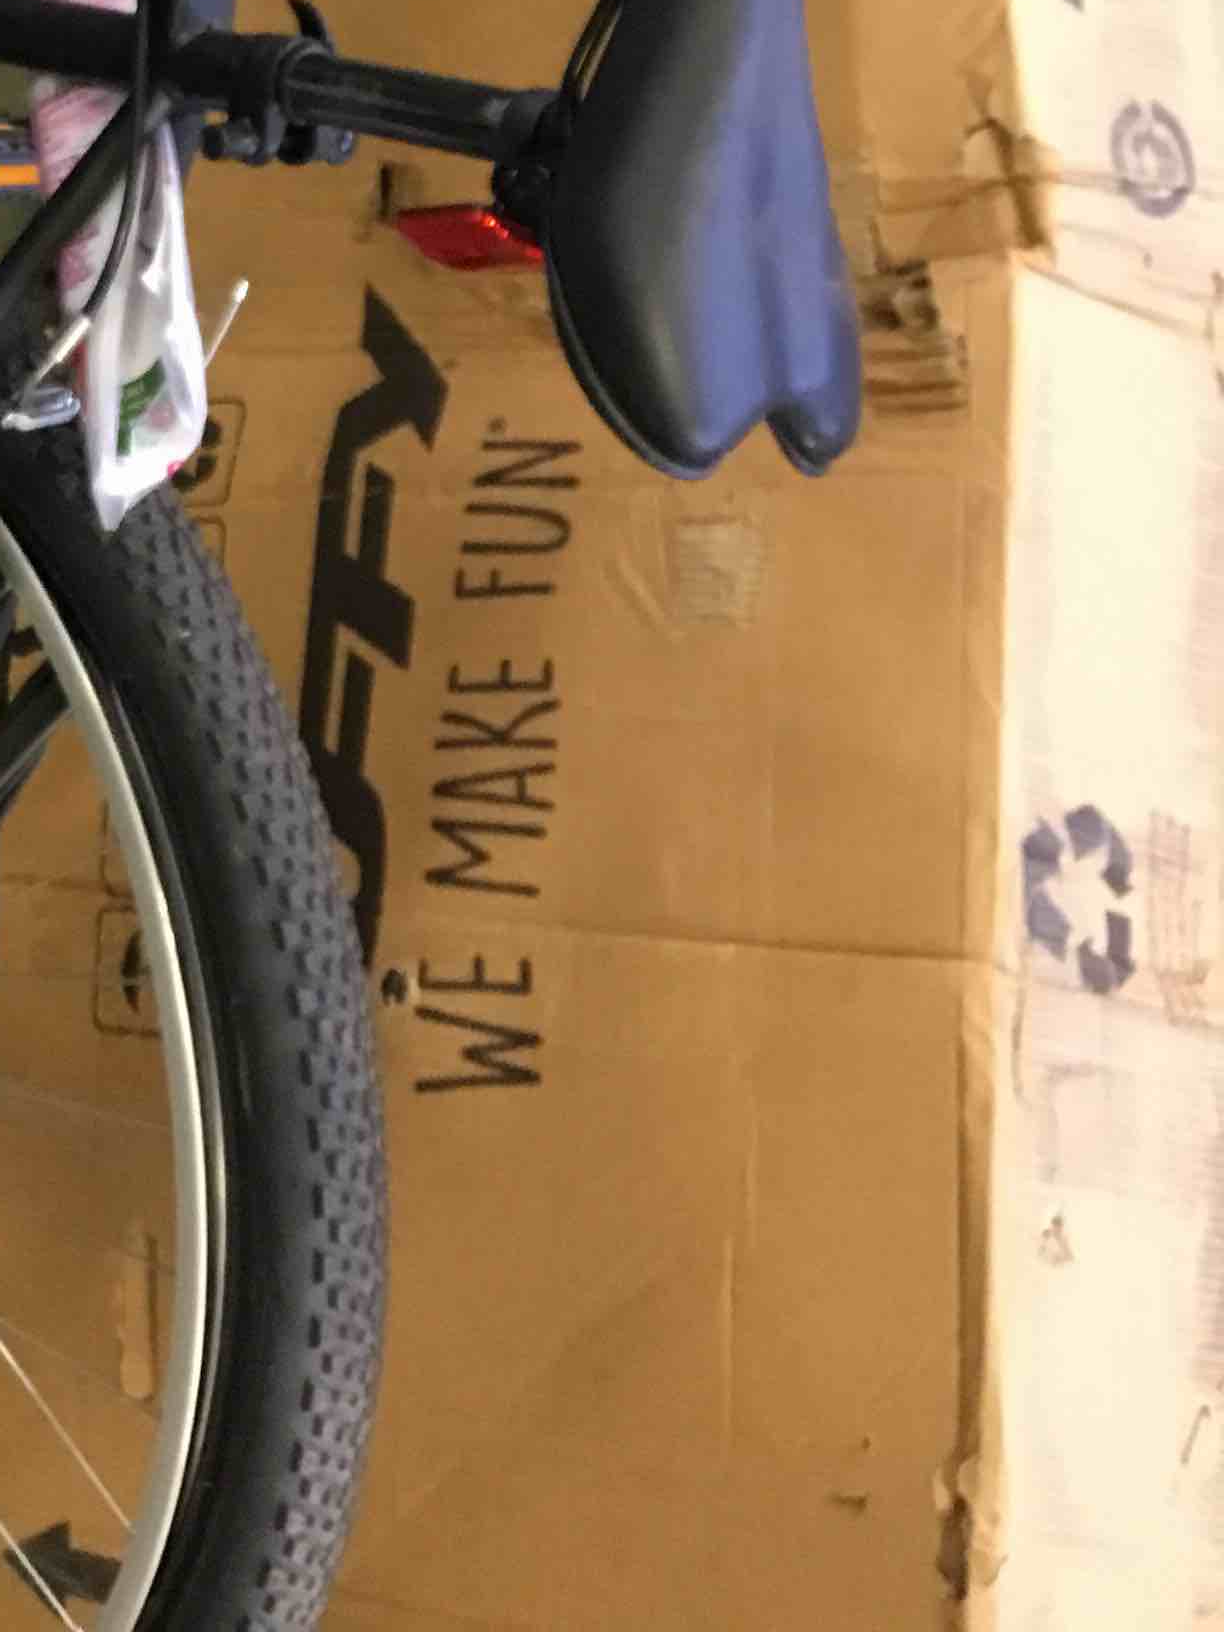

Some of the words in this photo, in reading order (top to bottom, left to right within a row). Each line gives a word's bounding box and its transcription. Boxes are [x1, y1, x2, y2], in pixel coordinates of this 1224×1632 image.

[297, 285, 448, 970] UFFY
[424, 657, 561, 898] MAKE
[413, 956, 543, 1095] WE
